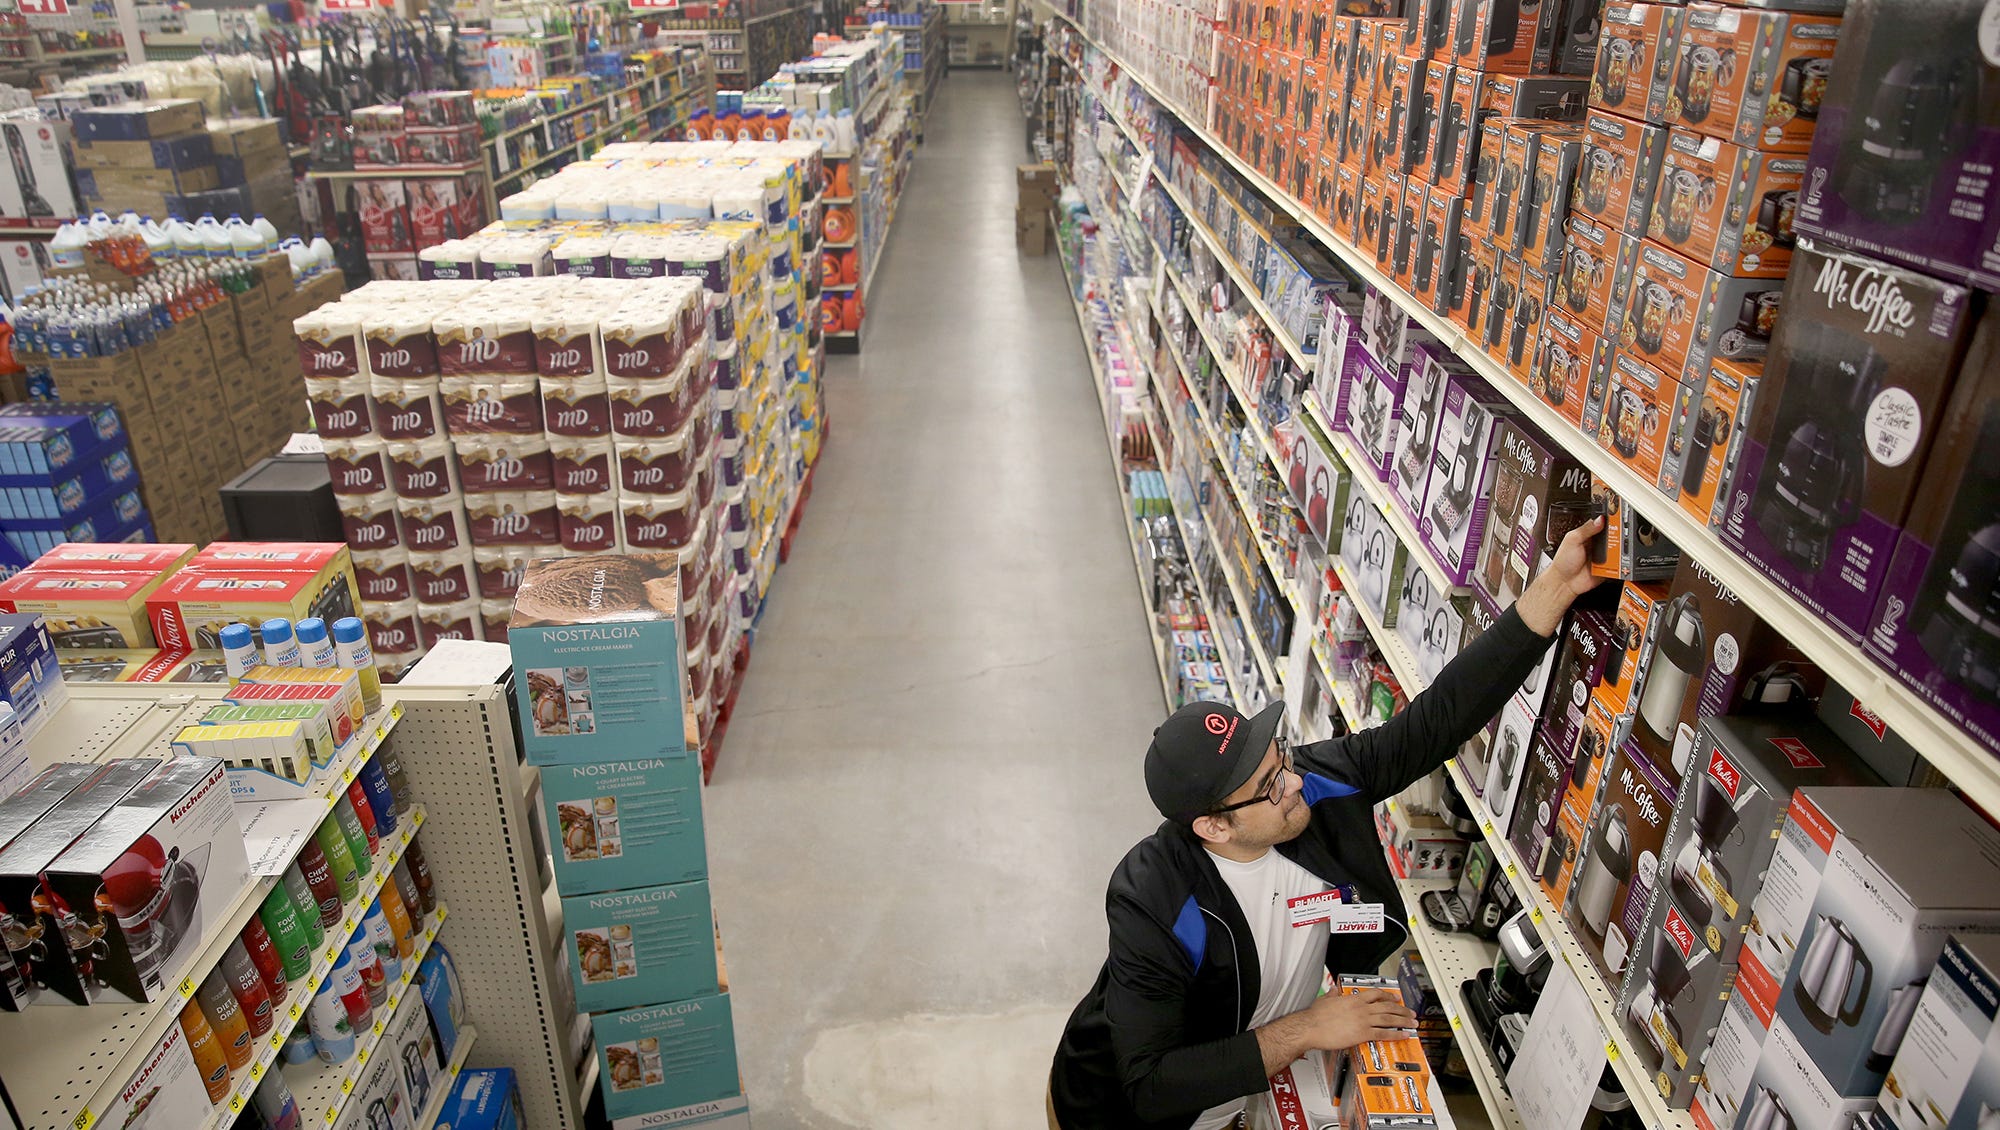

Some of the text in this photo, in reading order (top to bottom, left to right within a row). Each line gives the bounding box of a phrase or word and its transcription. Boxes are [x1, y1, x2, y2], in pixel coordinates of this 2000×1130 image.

[1590, 118, 1607, 132] Proctor
[1809, 167, 1828, 198] 12
[1644, 250, 1683, 275] Proctor Silex
[1813, 258, 1916, 334] Mr. Coffee
[1619, 358, 1656, 385] Proctor Silex
[1504, 432, 1538, 474] Mr. Coffee
[1559, 468, 1589, 493] Mr.
[1733, 489, 1749, 519] 12
[1745, 550, 1769, 573] AMERICA'S
[589, 568, 606, 611] NOSTALGIA
[1883, 595, 1905, 631] 12
[542, 627, 641, 643] NOSTALGIA
[1570, 620, 1597, 657] Mr. Coffee
[0, 649, 16, 668] PUR
[139, 650, 183, 682] unbeam
[1965, 719, 2000, 752] COFFEEMA
[572, 759, 665, 778] NOSTALGIA
[1544, 753, 1560, 780] Coffee
[1713, 759, 1735, 790] Melitta
[171, 768, 224, 825] KitchenAid
[1620, 768, 1660, 824] Mr. Coffee
[1659, 731, 1703, 877] POUR-OVER COFFEEMAKER
[1792, 797, 1832, 842] Digital Water Kettle
[1775, 850, 1799, 877] Features
[309, 873, 329, 885] COLA
[590, 890, 678, 909] NOSTALGIA
[280, 921, 297, 935] MIST
[1669, 918, 1688, 949] Melitta
[1616, 962, 1636, 1017] POUR-OVER
[1634, 887, 1660, 959] COFFEEMAKER
[239, 968, 254, 982] DIET
[1944, 943, 1999, 1007] Water Kettle
[216, 1000, 233, 1013] DIET
[1738, 970, 1750, 989] Digital
[1759, 1000, 1771, 1019] Kettle
[618, 1002, 702, 1025] NOSTALGIA
[1920, 1001, 1948, 1037] Features
[1724, 1016, 1741, 1044] Features
[123, 1027, 180, 1104] KitchenAid
[641, 1103, 720, 1126] NOSTALGIA
